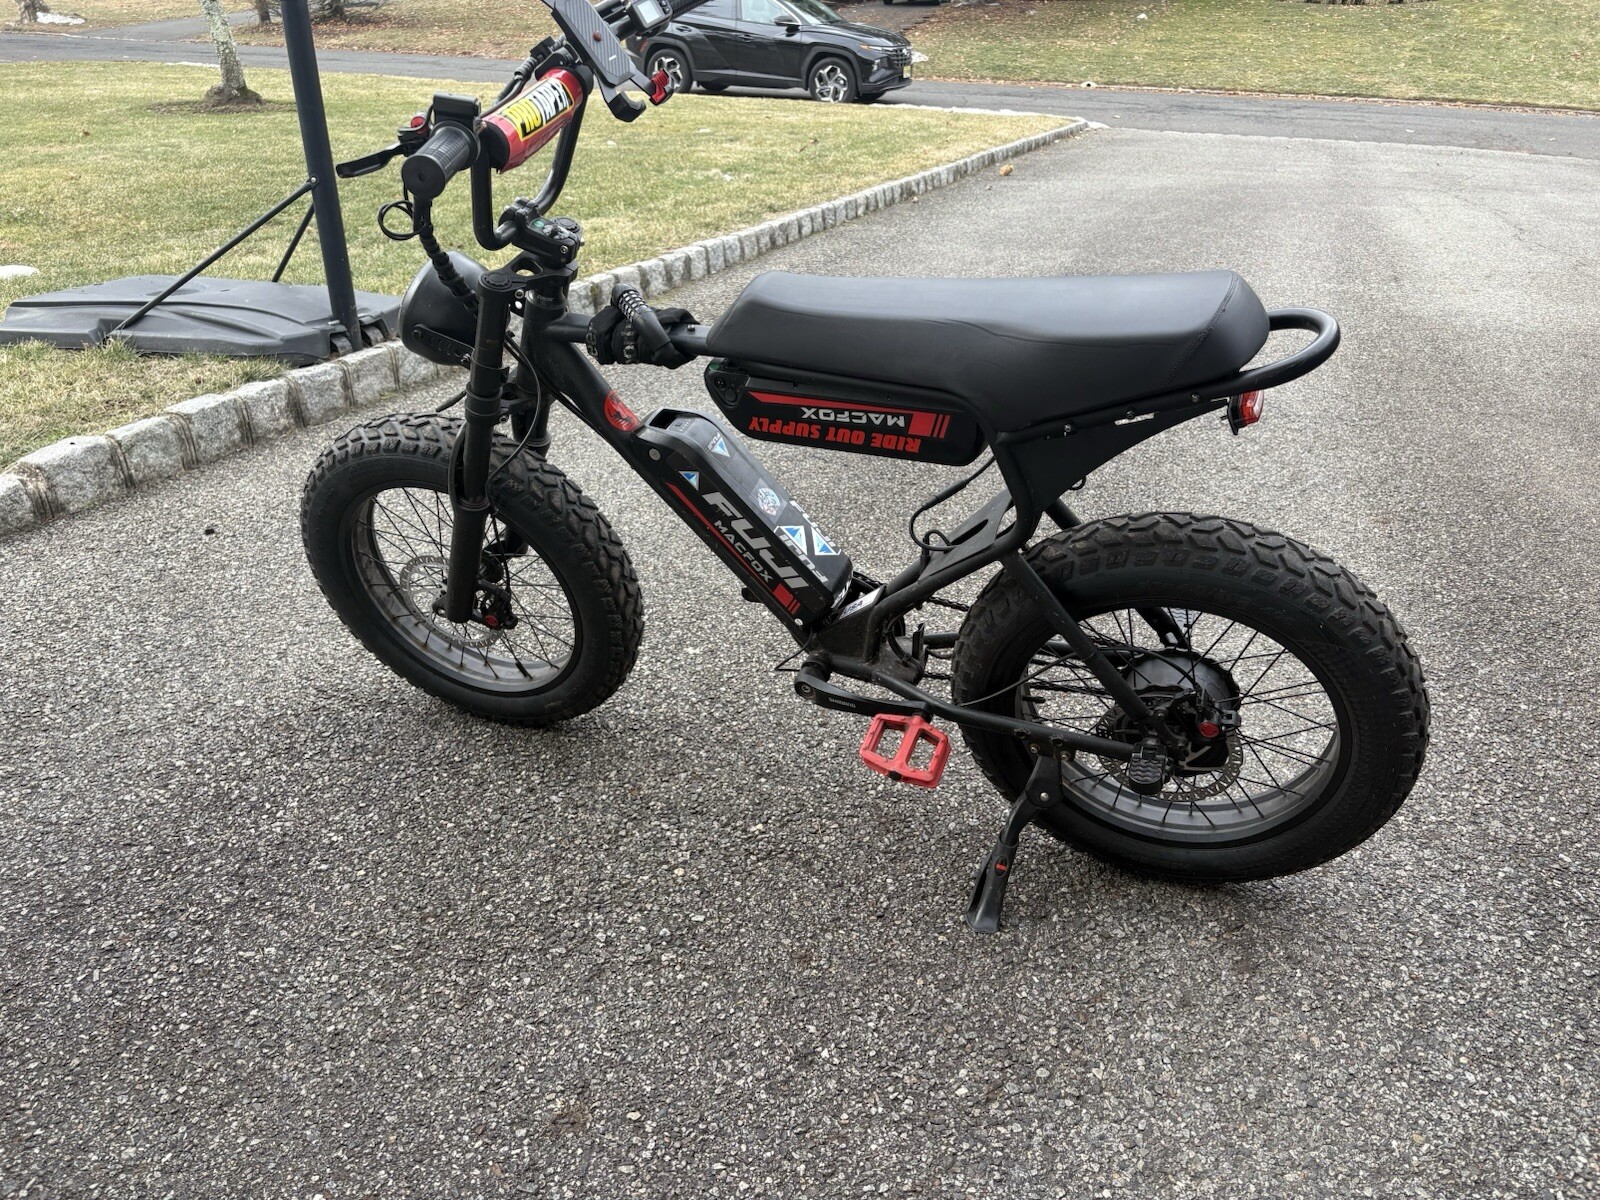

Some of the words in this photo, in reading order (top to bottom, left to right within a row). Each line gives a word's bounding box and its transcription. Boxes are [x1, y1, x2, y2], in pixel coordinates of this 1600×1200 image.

[748, 416, 821, 439] SUPPLY
[801, 406, 905, 428] MACFOX
[825, 426, 866, 446] OUT
[870, 432, 921, 454] RIDE
[702, 491, 810, 588] FUJI
[714, 519, 774, 583] MACFOX
[779, 533, 829, 583] FUJI
